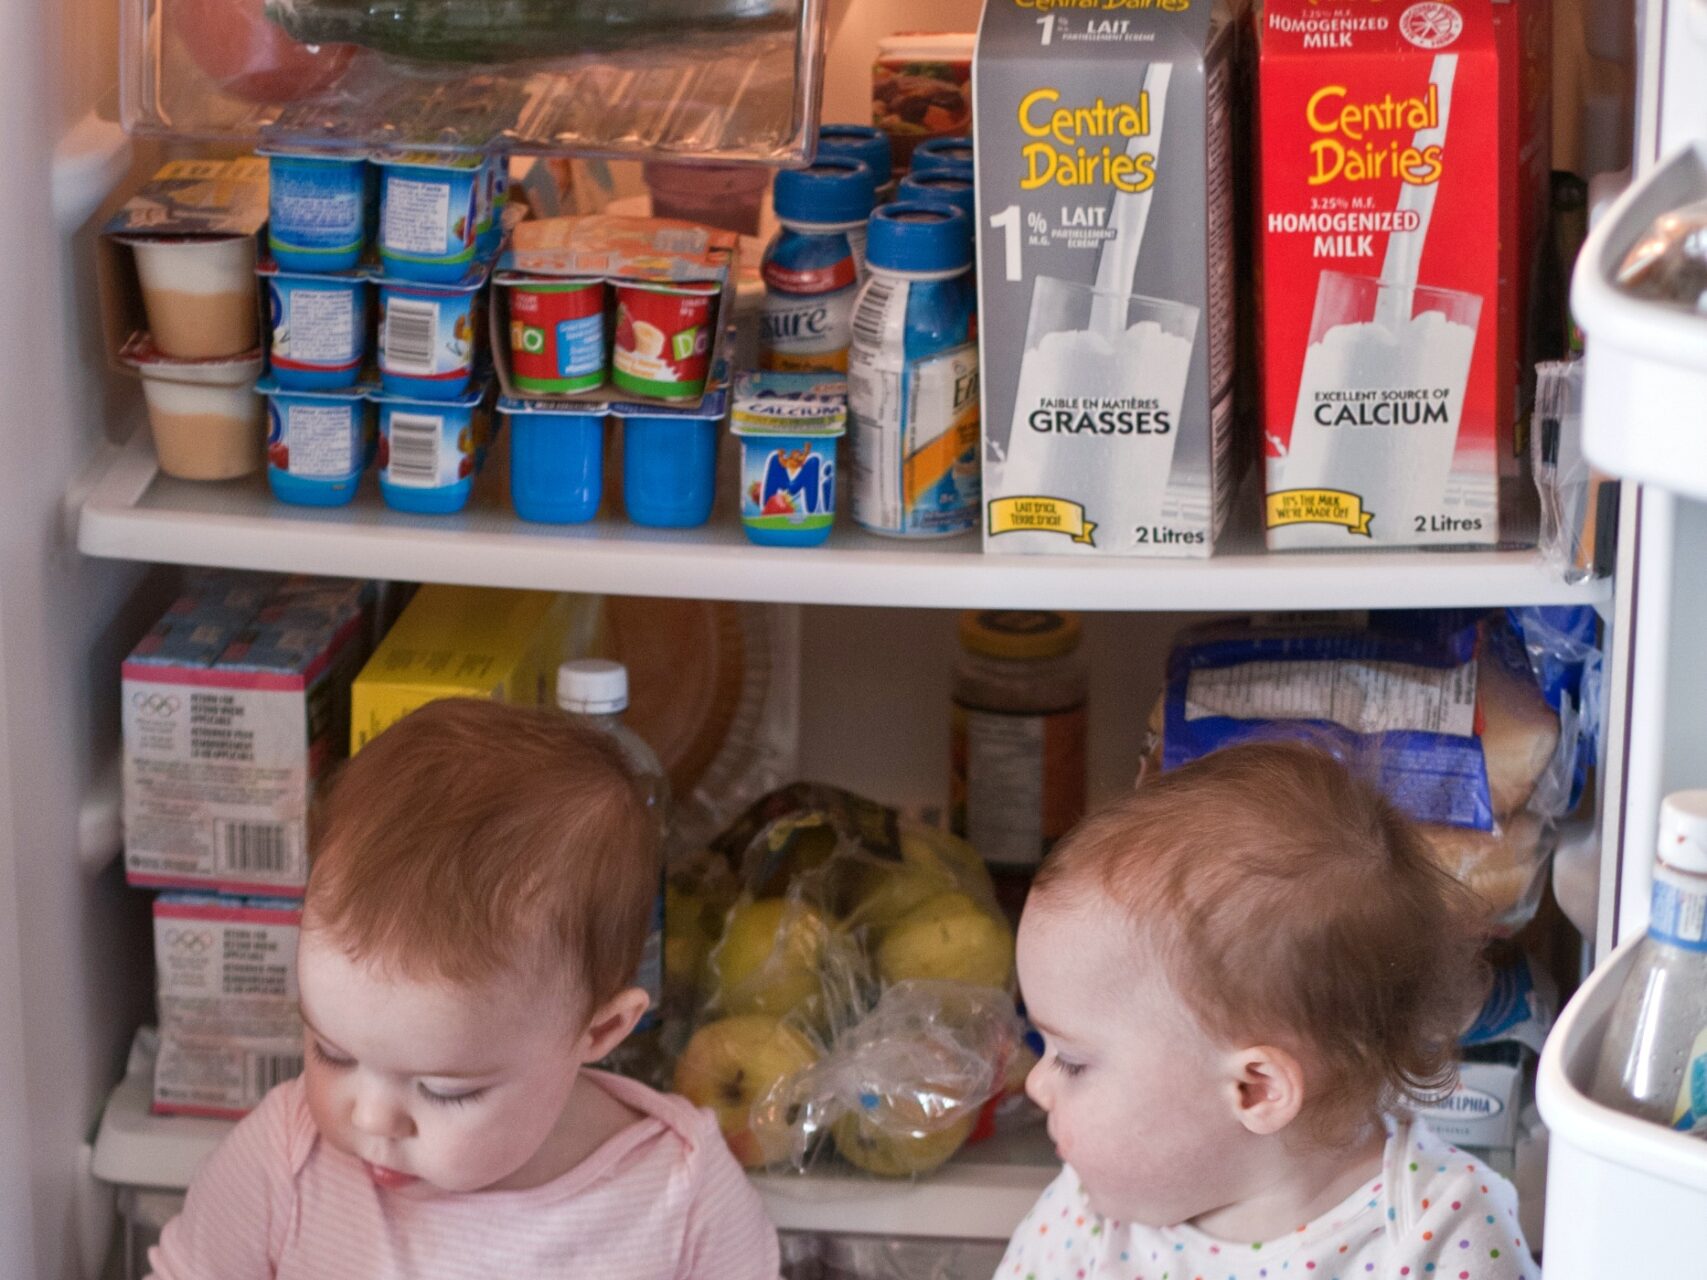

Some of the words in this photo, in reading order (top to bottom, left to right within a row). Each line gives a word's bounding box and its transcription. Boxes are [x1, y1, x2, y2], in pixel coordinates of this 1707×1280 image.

[1036, 14, 1056, 46] 1
[1087, 20, 1130, 34] LAIT
[1268, 13, 1389, 32] HOMOGENIZED
[1303, 32, 1353, 48] MILK
[1018, 88, 1149, 146] Central
[1306, 83, 1438, 141] Central
[1020, 141, 1156, 194] Dairies
[1308, 138, 1442, 186] Dairies
[1310, 197, 1349, 210] 3.25%
[1351, 196, 1376, 209] M.F.
[1061, 206, 1106, 226] LAIT
[1268, 211, 1420, 233] HOMOGENIZED
[989, 204, 1022, 282] 1
[1312, 234, 1374, 258] MILK
[1040, 398, 1079, 409] FAIBLE
[1082, 398, 1099, 409] EN
[1101, 396, 1159, 409] MATIÈRES
[1314, 390, 1378, 402] EXCELLENT
[1381, 389, 1429, 401] SOURCE
[1432, 388, 1450, 399] OF
[1028, 410, 1171, 435] GRASSES
[1313, 401, 1449, 426] CALCIUM
[1414, 515, 1427, 532] 2
[1431, 515, 1483, 532] Litres
[1135, 526, 1149, 543] 2
[1152, 526, 1205, 544] Litres
